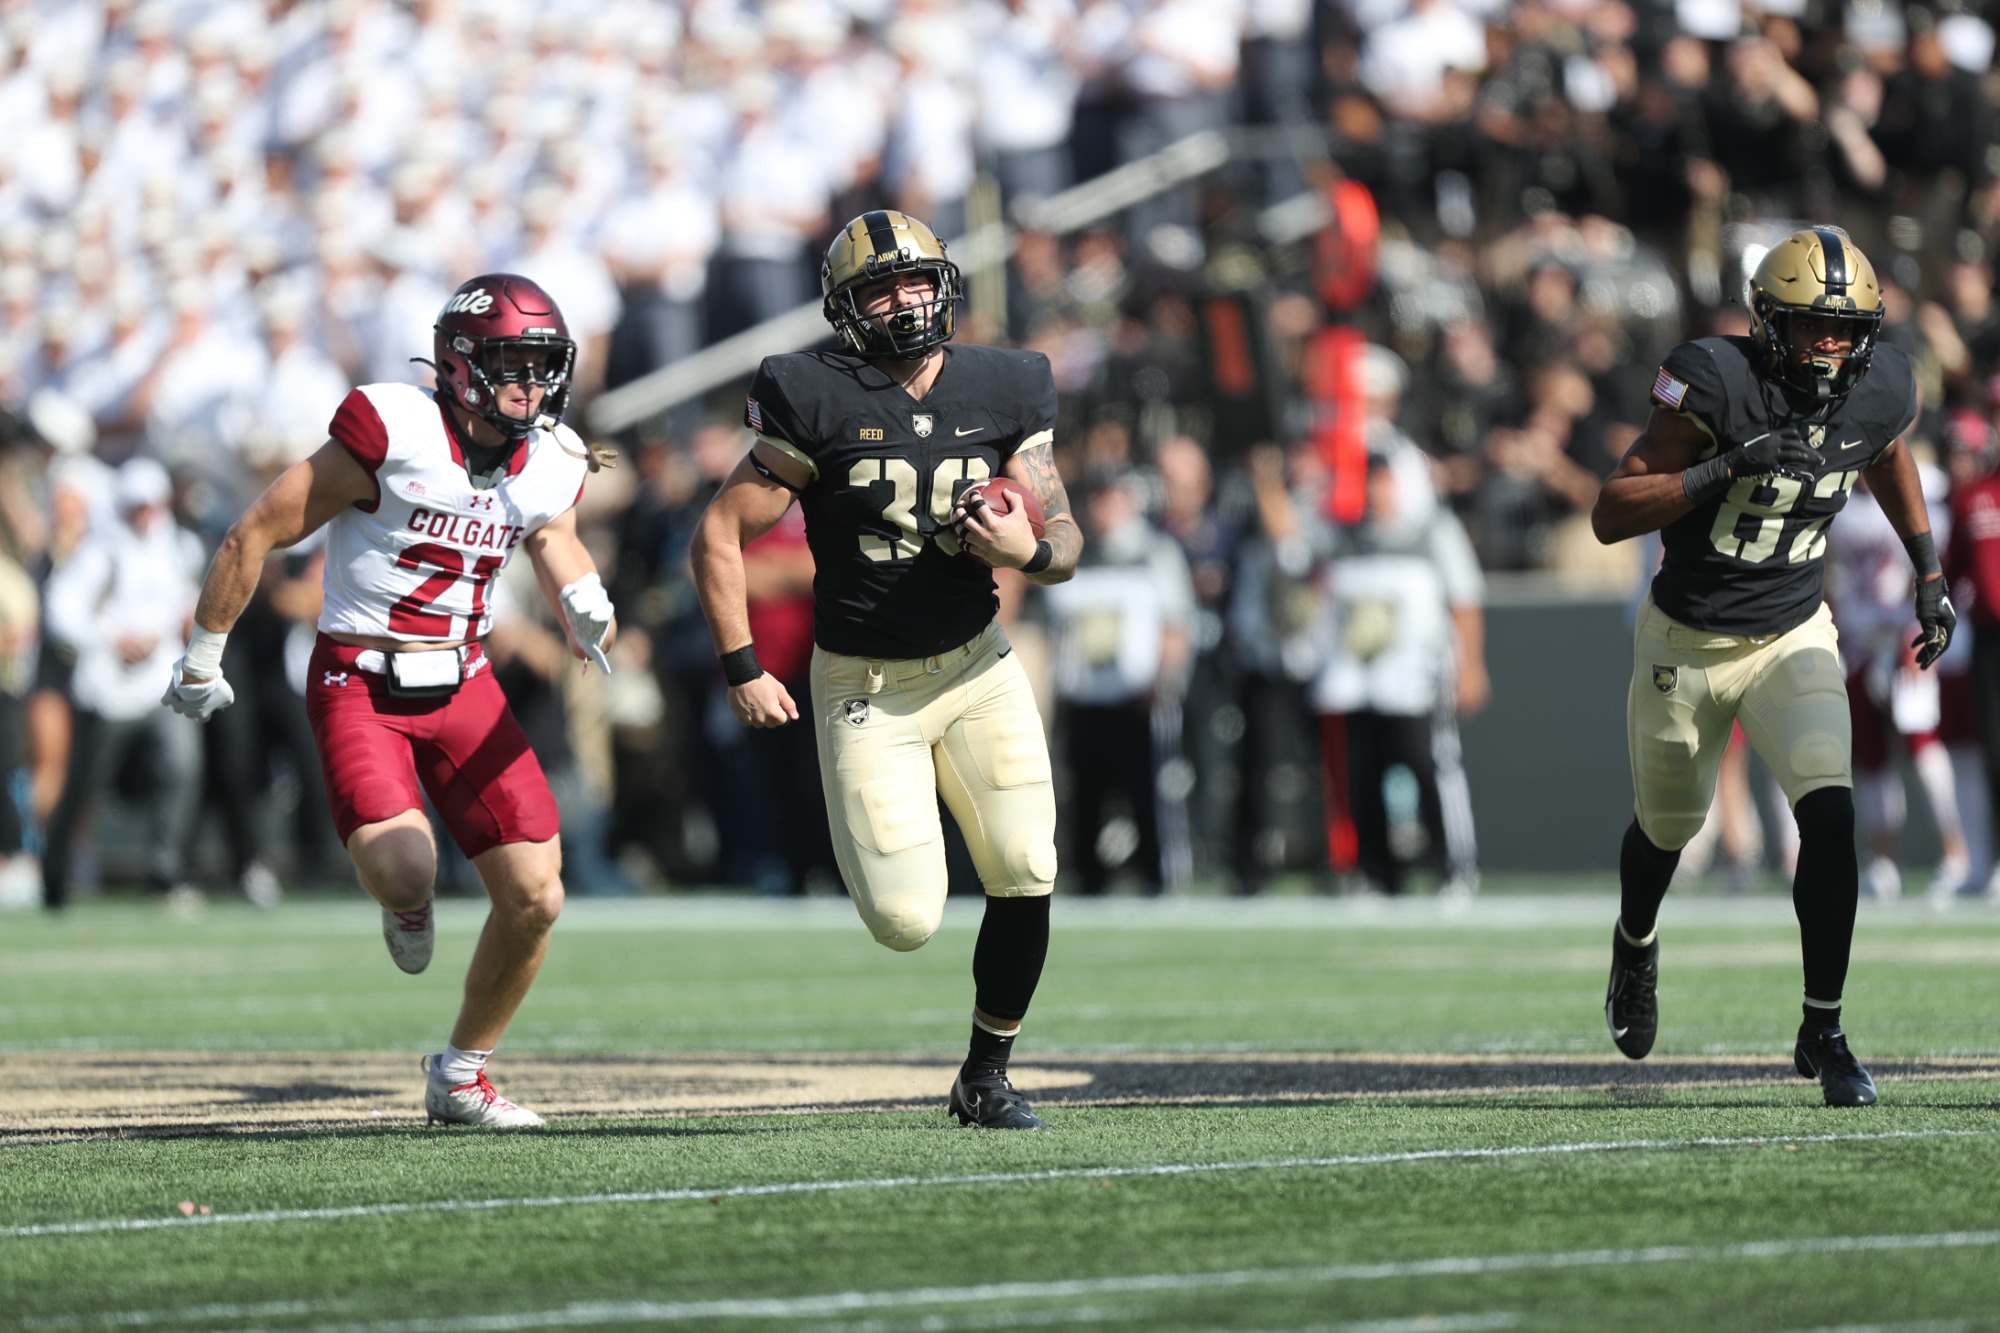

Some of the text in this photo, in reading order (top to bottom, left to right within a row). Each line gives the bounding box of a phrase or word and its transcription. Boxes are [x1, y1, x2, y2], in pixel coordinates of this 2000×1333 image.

[877, 249, 900, 264] ARMY
[446, 288, 494, 315] ate
[1824, 296, 1848, 309] ARMY
[859, 428, 884, 441] REED
[407, 507, 526, 550] COLGATE
[1709, 468, 1860, 566] 82
[388, 541, 505, 640] 21
